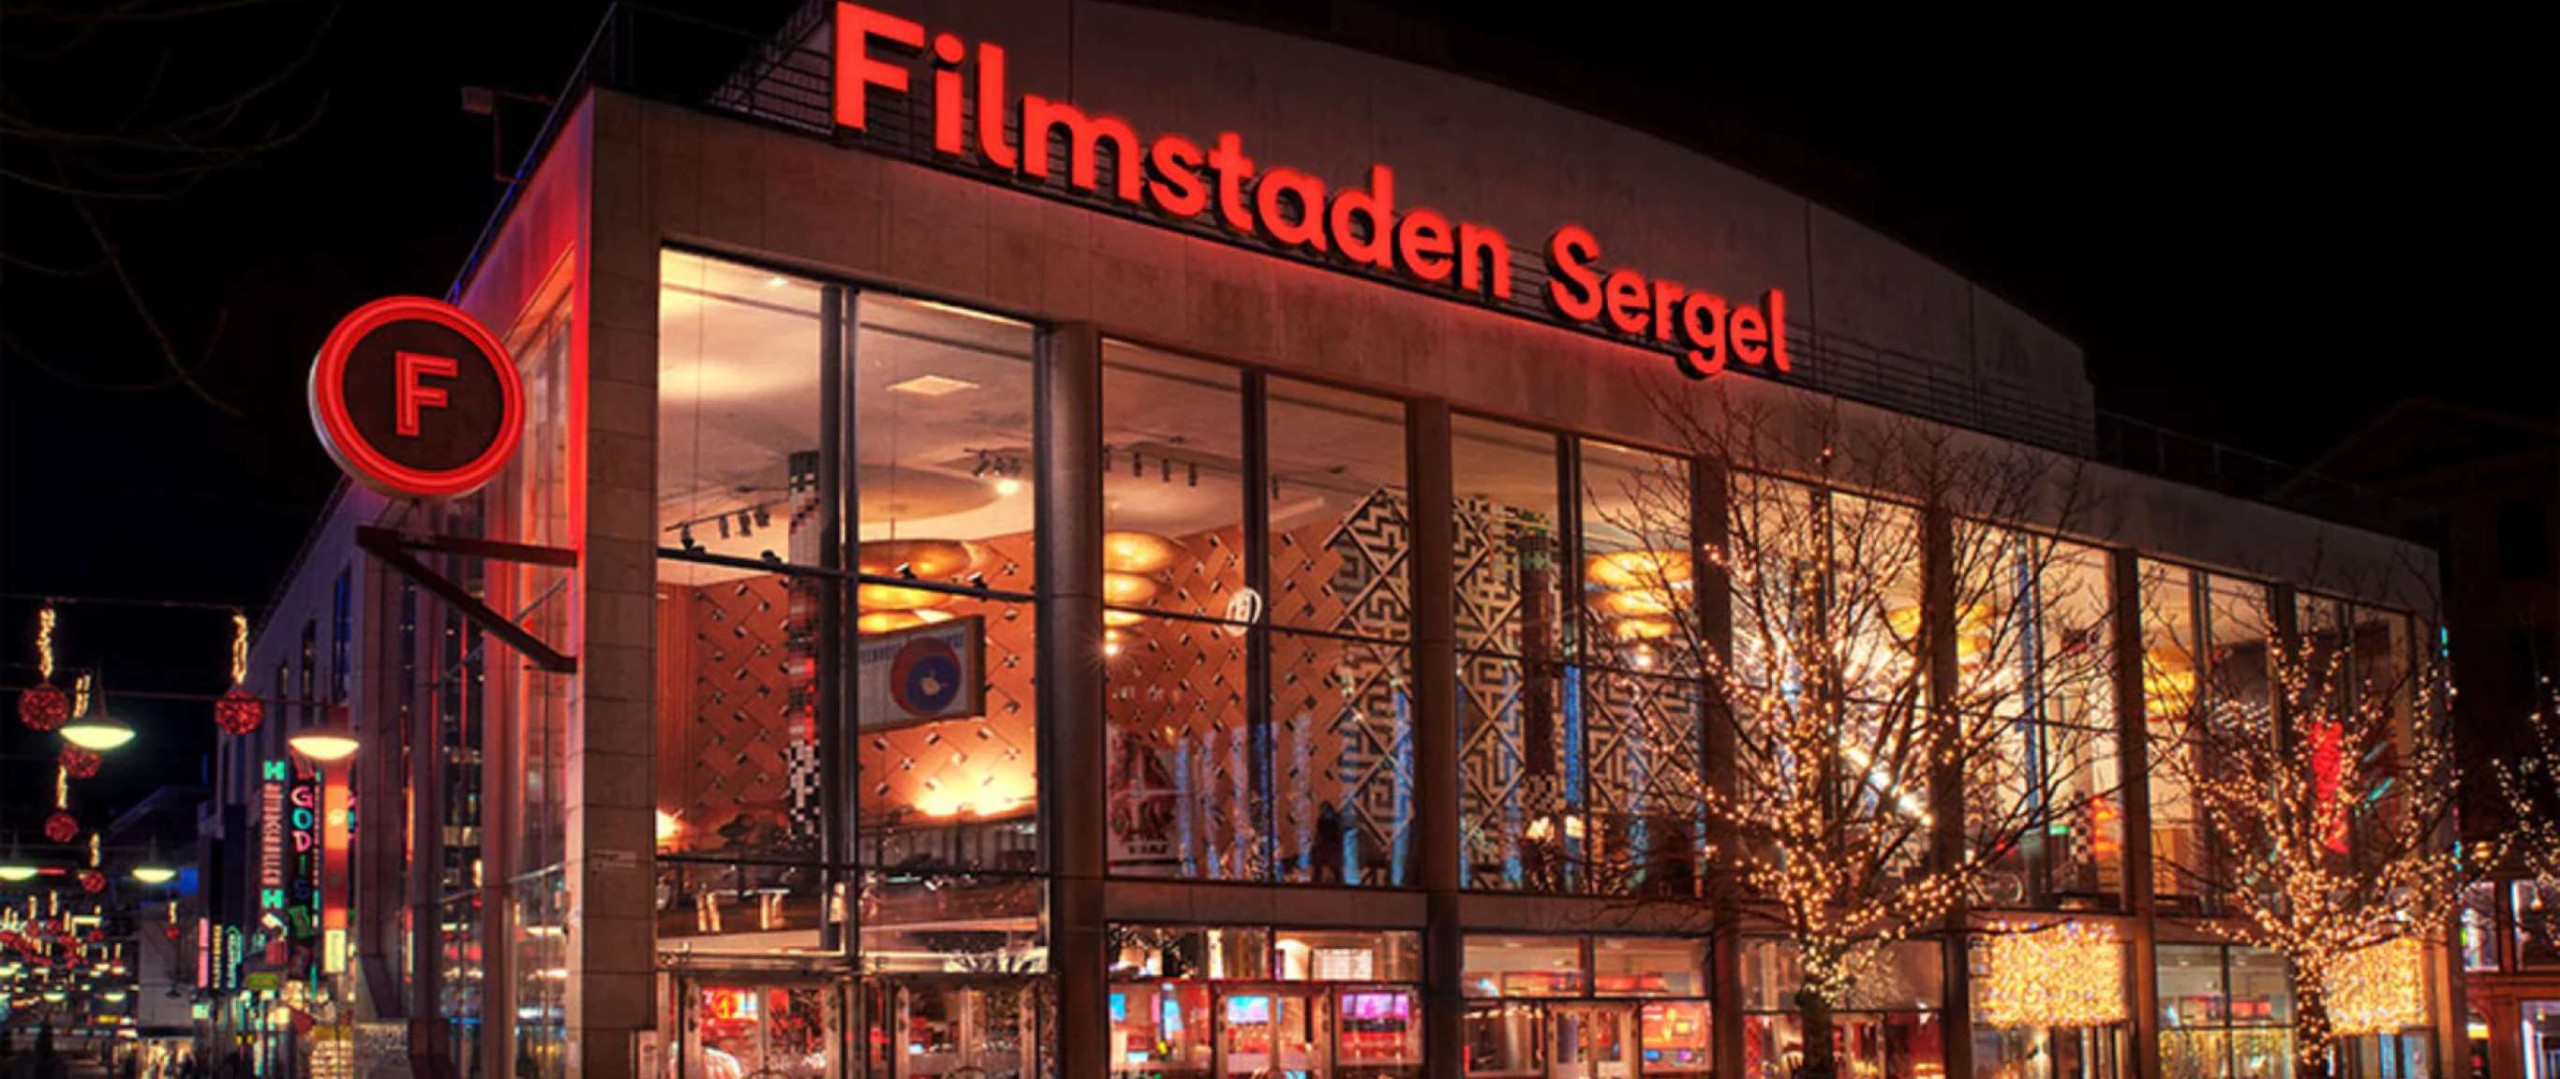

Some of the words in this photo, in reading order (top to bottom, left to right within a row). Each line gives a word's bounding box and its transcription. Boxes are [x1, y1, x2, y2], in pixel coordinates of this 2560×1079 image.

[834, 1, 1512, 300] Filmstaden
[1547, 225, 1791, 376] Sergel
[395, 352, 458, 436] F
